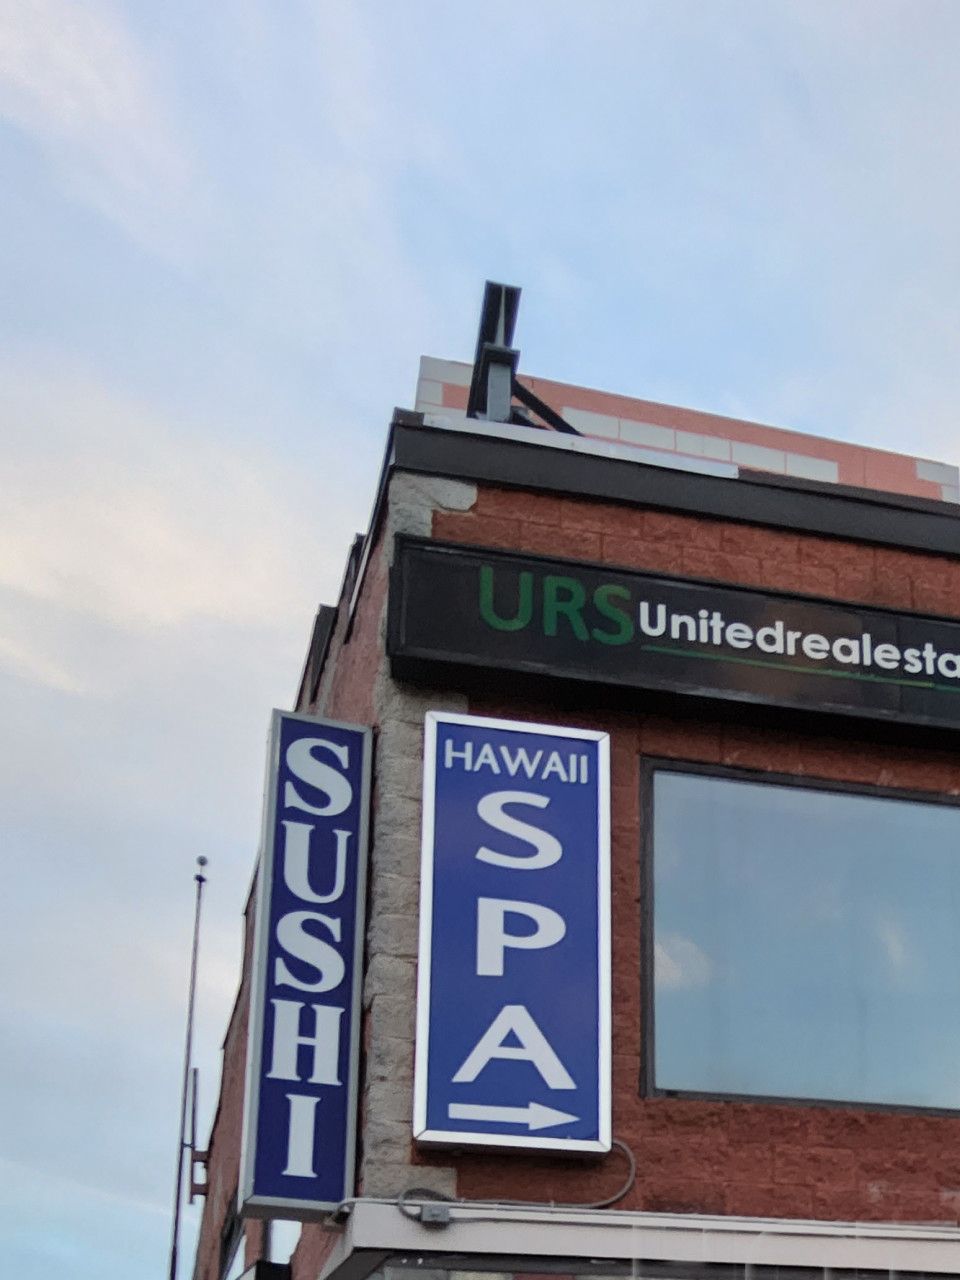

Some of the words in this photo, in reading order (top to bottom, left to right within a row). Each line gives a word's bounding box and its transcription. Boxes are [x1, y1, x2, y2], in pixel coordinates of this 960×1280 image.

[479, 564, 635, 646] URS
[444, 737, 590, 785] HAWAII
[265, 736, 353, 1179] SUSHI
[451, 790, 578, 1091] SPA
